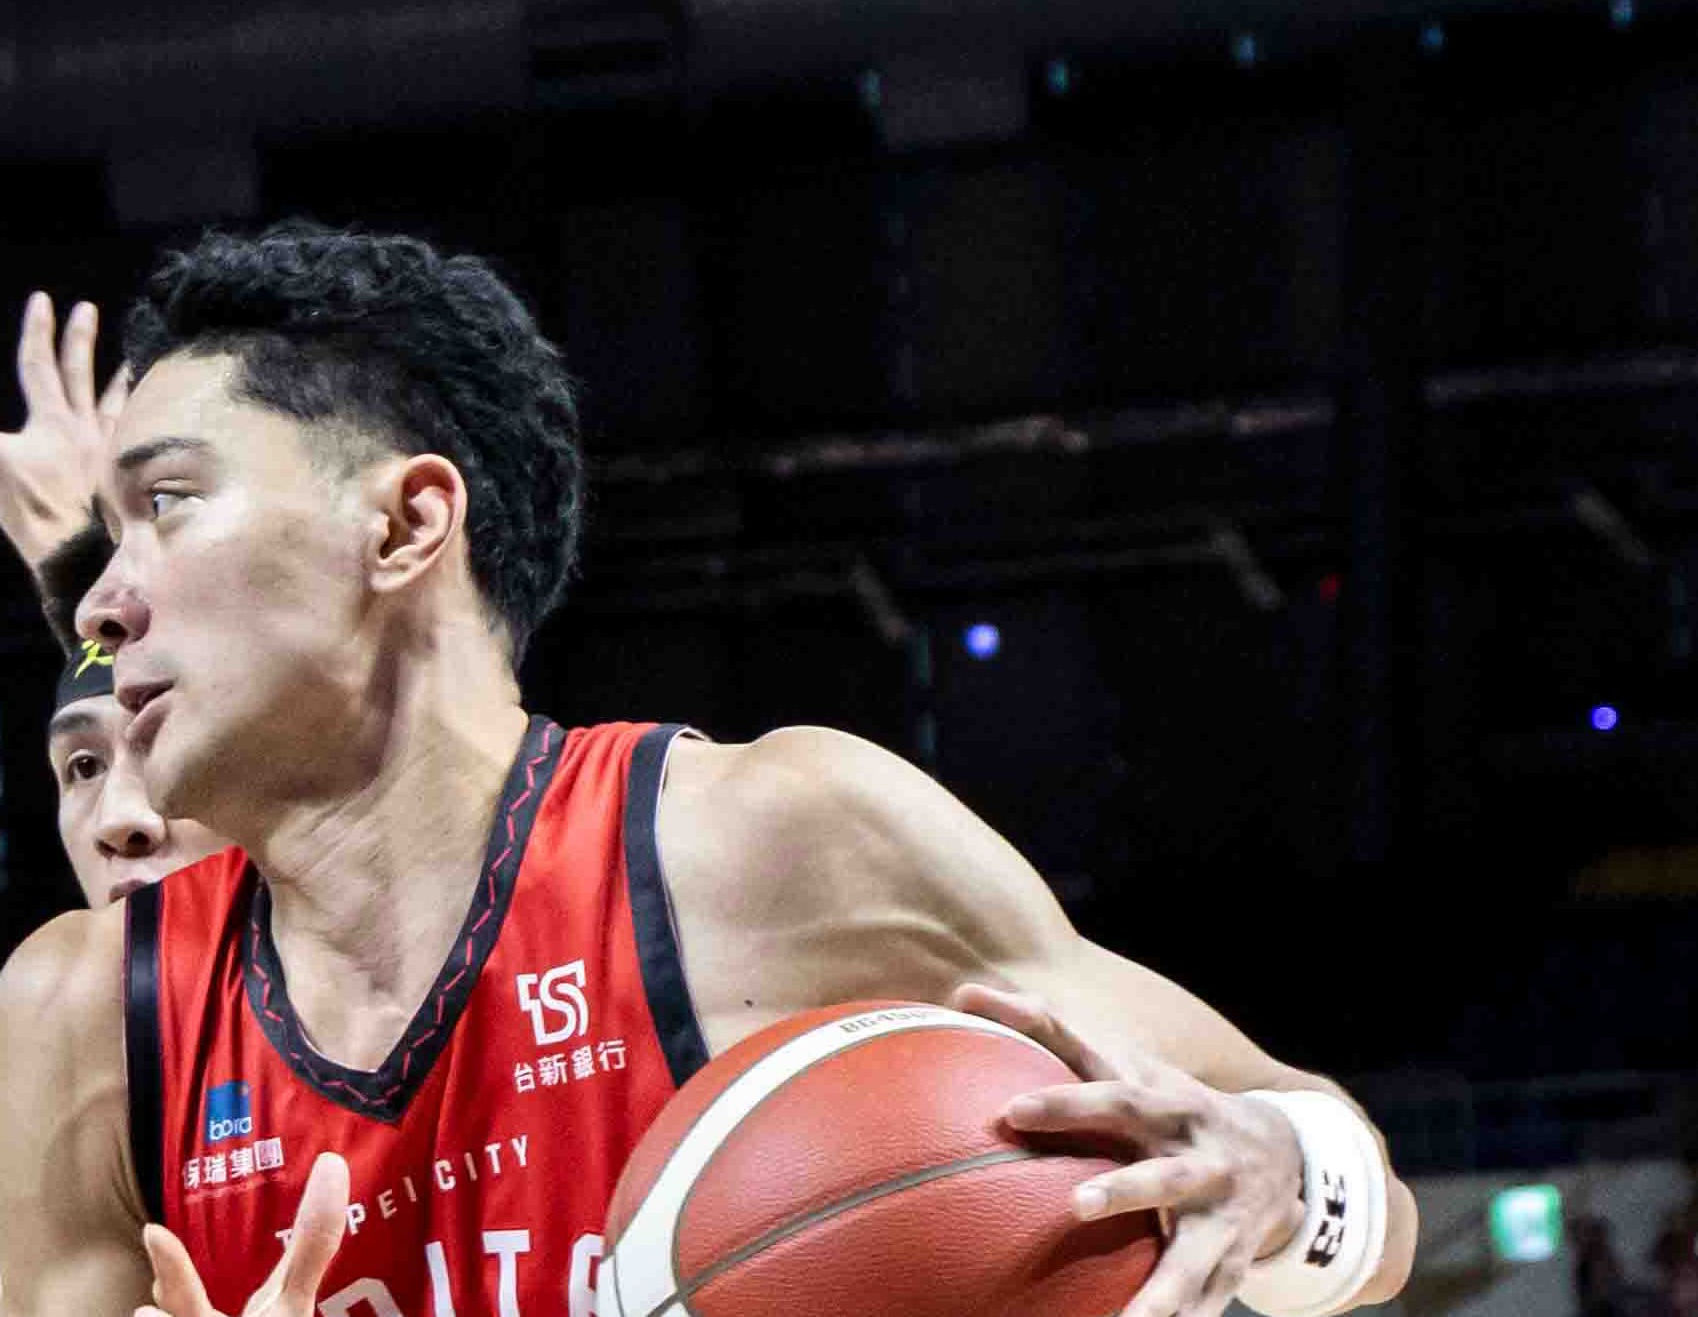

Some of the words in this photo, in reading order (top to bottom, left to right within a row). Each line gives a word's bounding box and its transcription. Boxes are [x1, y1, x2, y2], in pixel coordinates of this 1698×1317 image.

[513, 1038, 627, 1094] 台新銀行
[274, 1176, 417, 1252] TPEI
[433, 1134, 529, 1192] CITY
